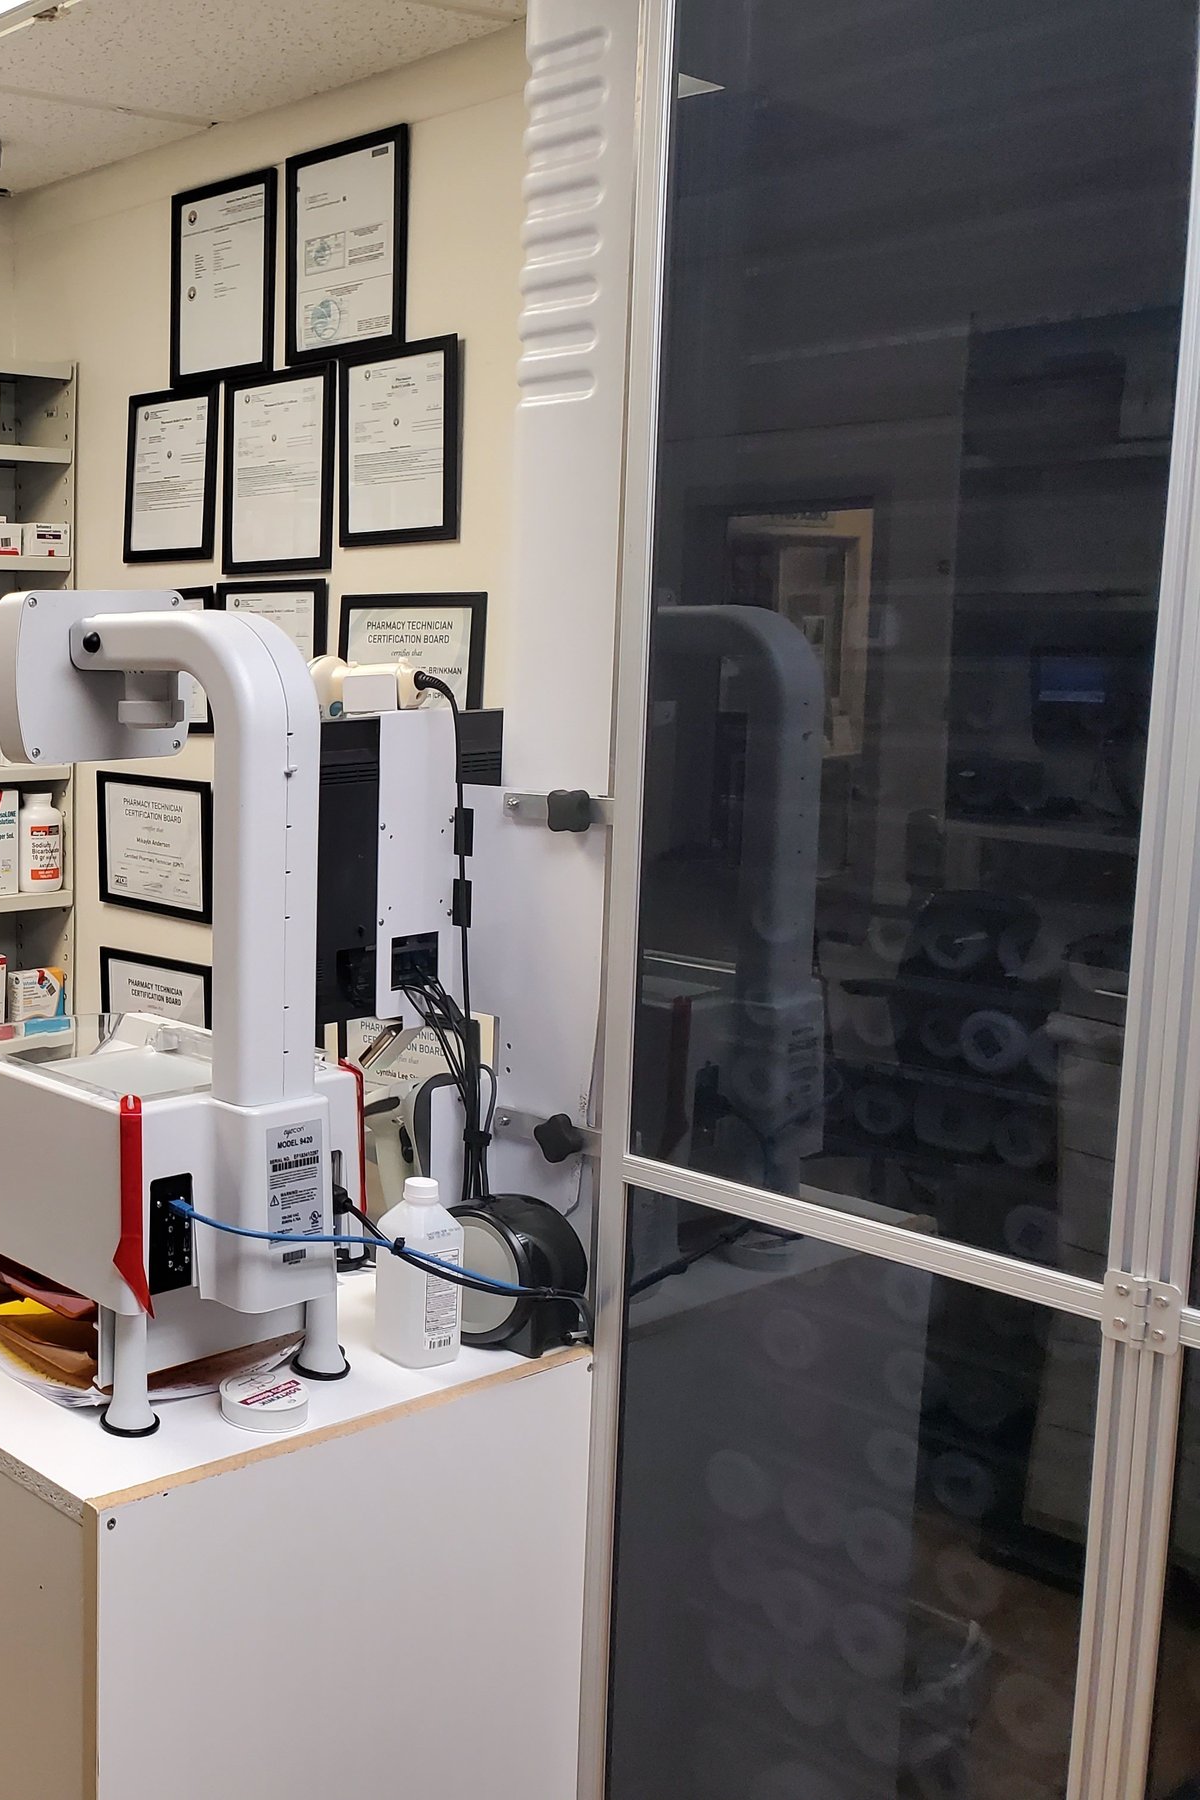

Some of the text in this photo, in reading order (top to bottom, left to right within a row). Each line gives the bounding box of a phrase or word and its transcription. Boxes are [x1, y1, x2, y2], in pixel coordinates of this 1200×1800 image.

[366, 620, 453, 630] PHARMACY TECHNICIAN
[367, 634, 450, 643] CERTIFICATION BOARD
[390, 648, 411, 657] certifies
[123, 797, 184, 813] PHARMACY TECHNICIAN
[124, 808, 182, 824] CERTIFICATION BOARD
[151, 839, 171, 848] Anderson
[123, 852, 139, 860] Certified
[139, 855, 155, 864] Pharmacy
[127, 978, 183, 996] PHARMACY TECHNICIAN
[131, 988, 182, 1006] CERTIFICATION BOARD
[360, 1021, 386, 1032] PHARM
[397, 1071, 409, 1080] Lee
[277, 1135, 313, 1149] MODEL 9420
